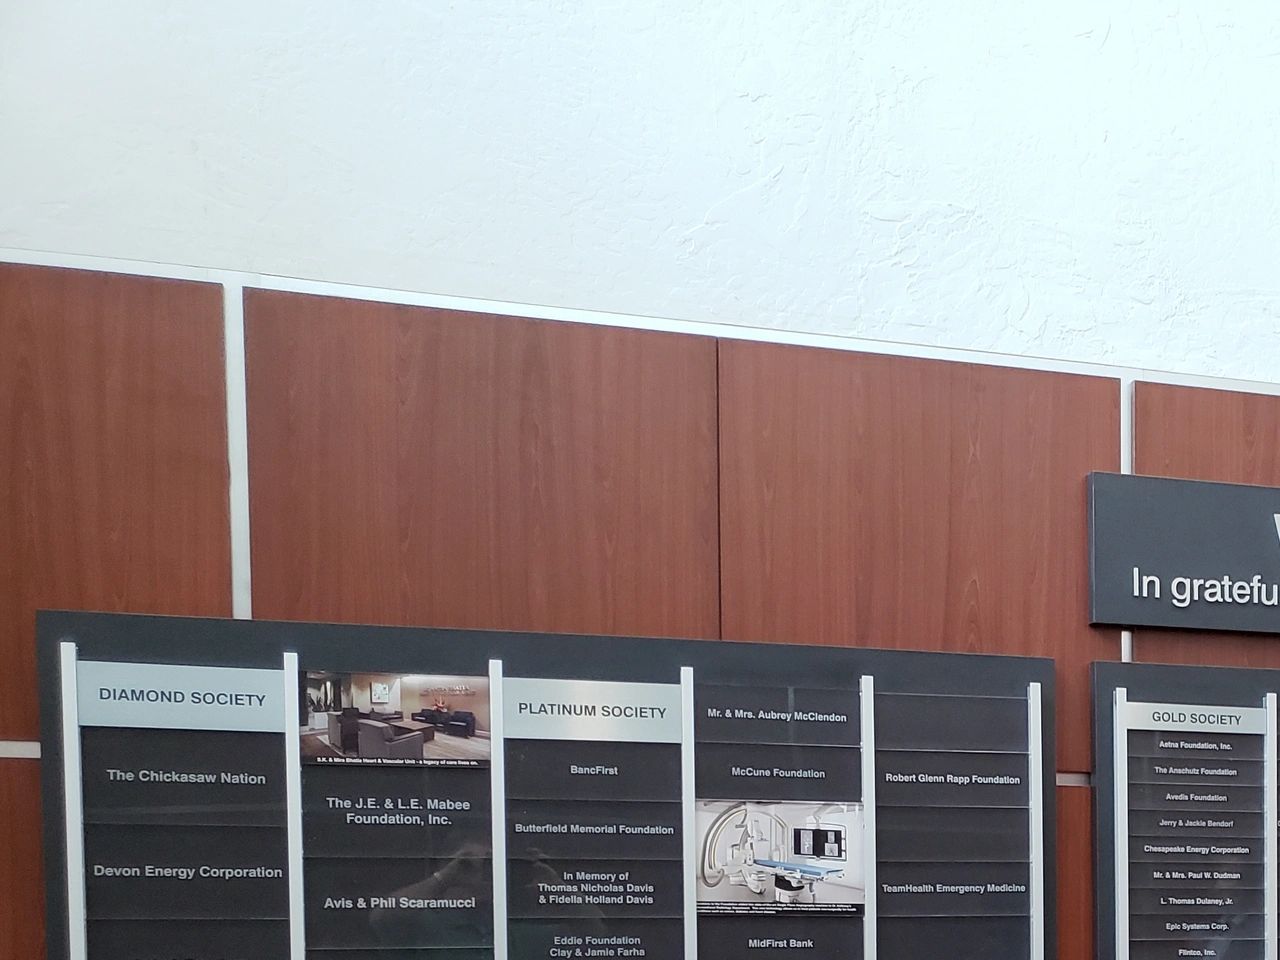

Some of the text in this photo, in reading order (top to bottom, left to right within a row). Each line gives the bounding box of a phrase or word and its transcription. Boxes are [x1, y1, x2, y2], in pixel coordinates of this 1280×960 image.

[1133, 567, 1160, 598] In
[99, 688, 265, 706] DIAMOND SOCIETY
[518, 702, 666, 718] PLATINUM SOCIETY
[1152, 711, 1241, 725] GOLD SOCIETY
[570, 765, 618, 775] BancFirst
[731, 767, 825, 778] McCune Foundation
[106, 769, 265, 784] The Chickasaw Nation
[885, 773, 1020, 785] Robert Glenn Rapp Foundation
[325, 797, 470, 810] The J.E. & L.E. Mabee
[346, 813, 452, 825] Foundation, Inc.
[515, 823, 674, 834] Butterfield Memorial Foundation
[94, 865, 282, 879] Devon Energy Corporation
[563, 871, 629, 882] In Memory of
[537, 883, 654, 892] Thomas Nicholas Davis
[882, 883, 1025, 894] TeamHealth Emergency Medicine
[324, 897, 475, 908] Avis & Phil Scaramucci
[538, 894, 546, 904] &
[585, 895, 623, 904] Holland
[626, 895, 653, 904] Davis
[553, 936, 640, 945] Eddie Foundation
[748, 939, 813, 947] MidFirst Bank
[549, 947, 645, 958] Clay & Jamie Farha
